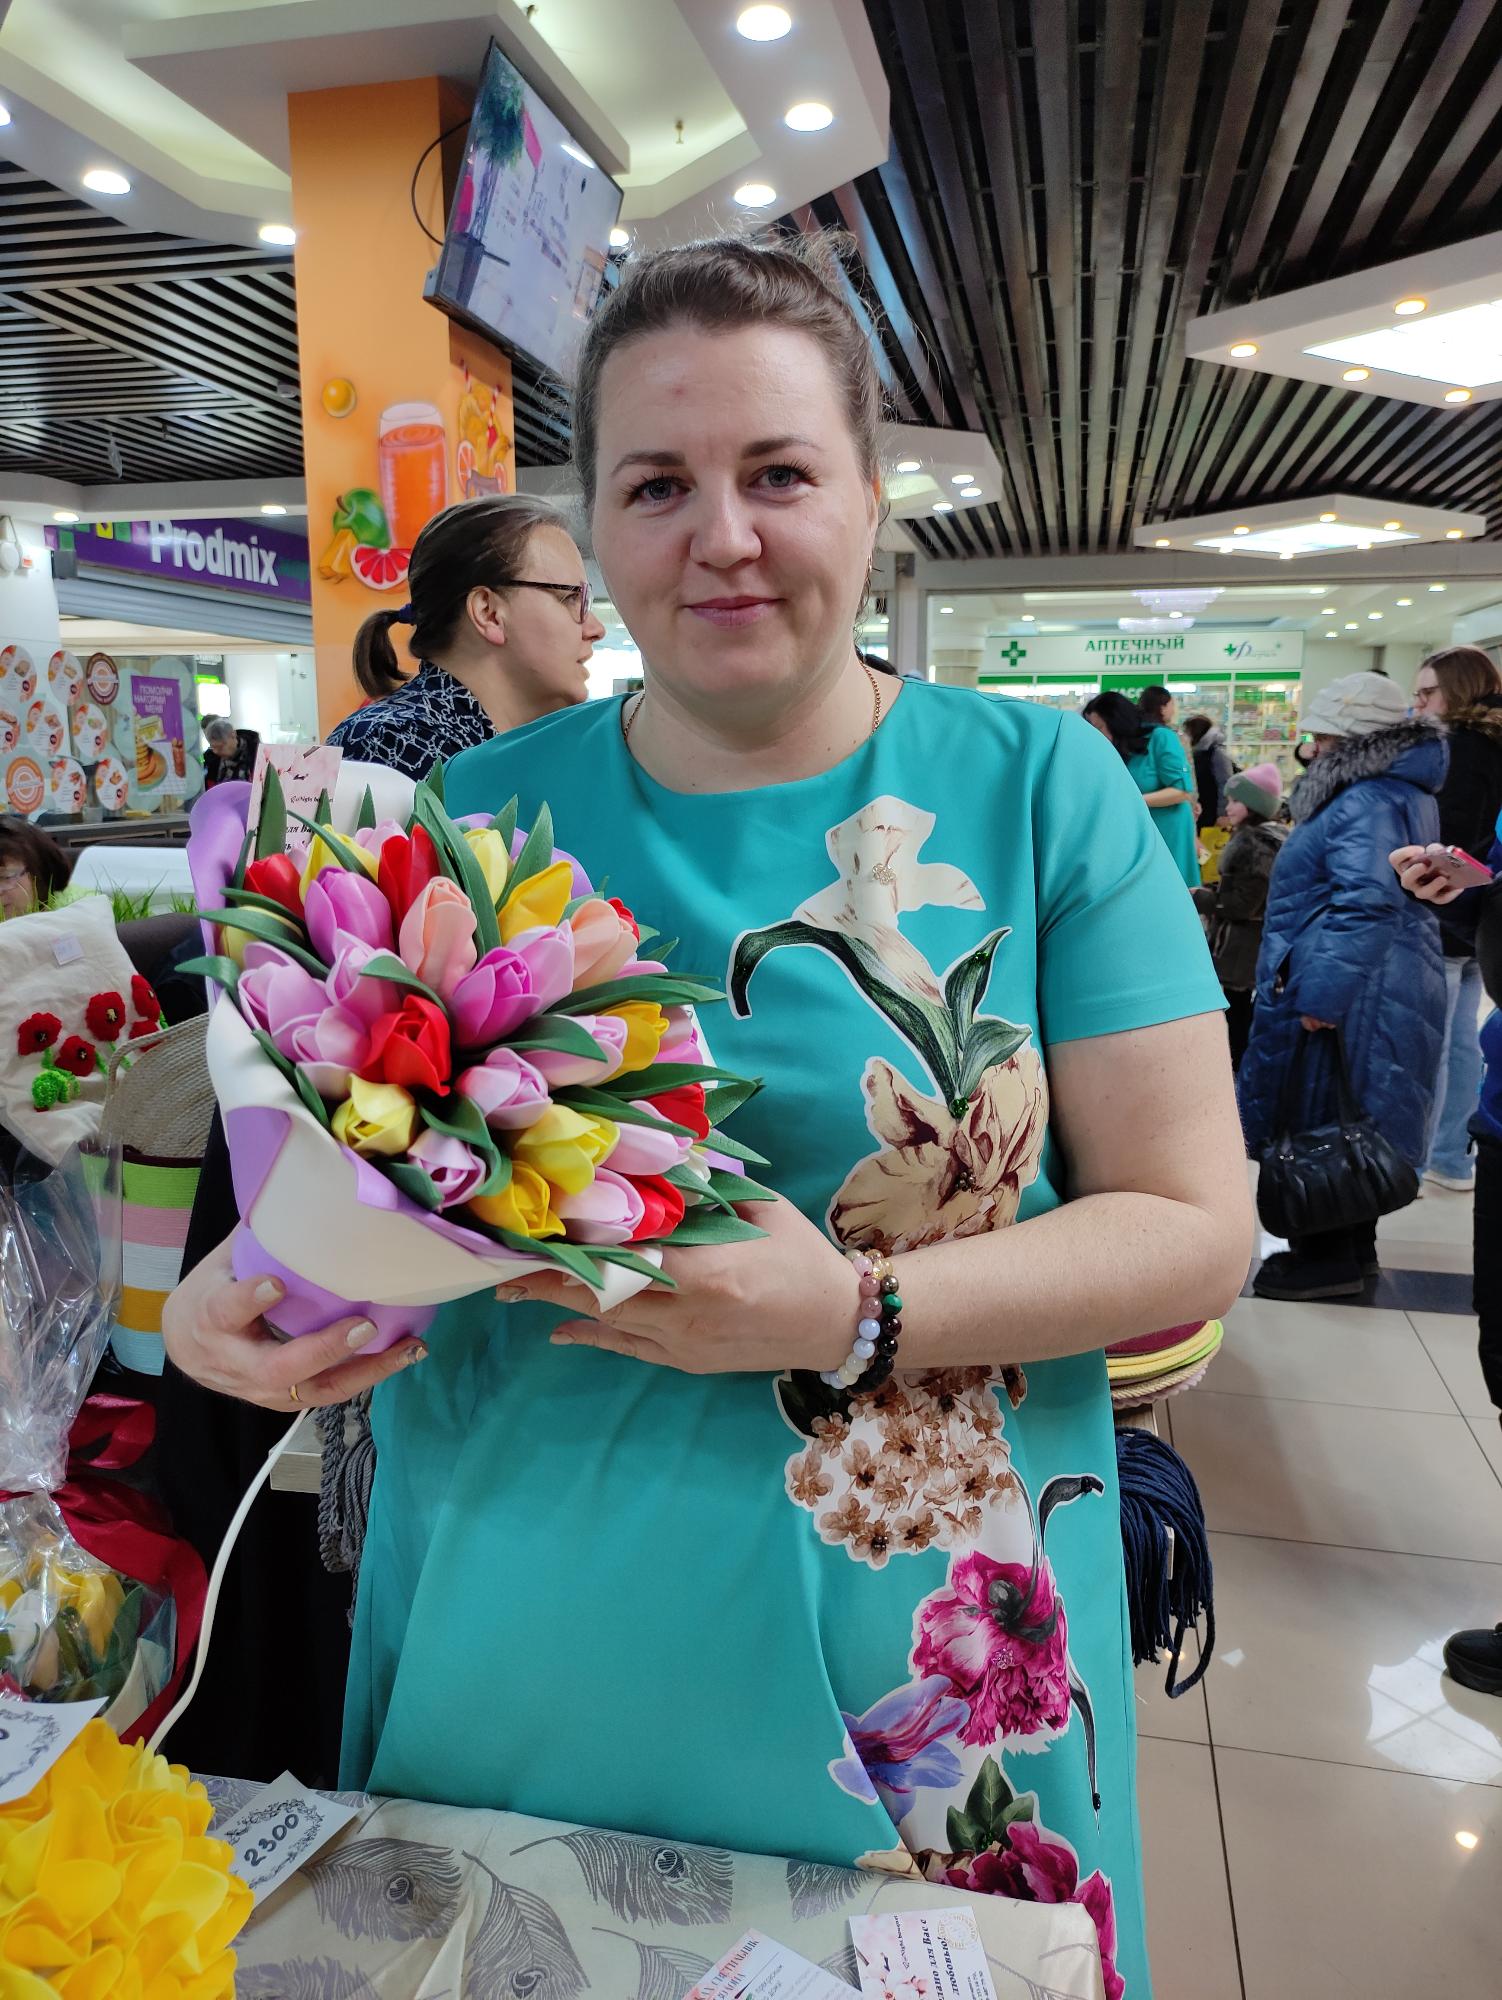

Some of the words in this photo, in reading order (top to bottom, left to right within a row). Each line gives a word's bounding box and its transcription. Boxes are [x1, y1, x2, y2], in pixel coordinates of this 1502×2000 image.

[149, 519, 279, 587] Prodmix
[1085, 635, 1185, 652] АПТЕЧНЫЙ
[1104, 653, 1165, 666] ПУНКТ
[244, 1813, 299, 1867] 2300
[922, 1926, 932, 1945] Вас
[937, 1936, 959, 1996] любовью!
